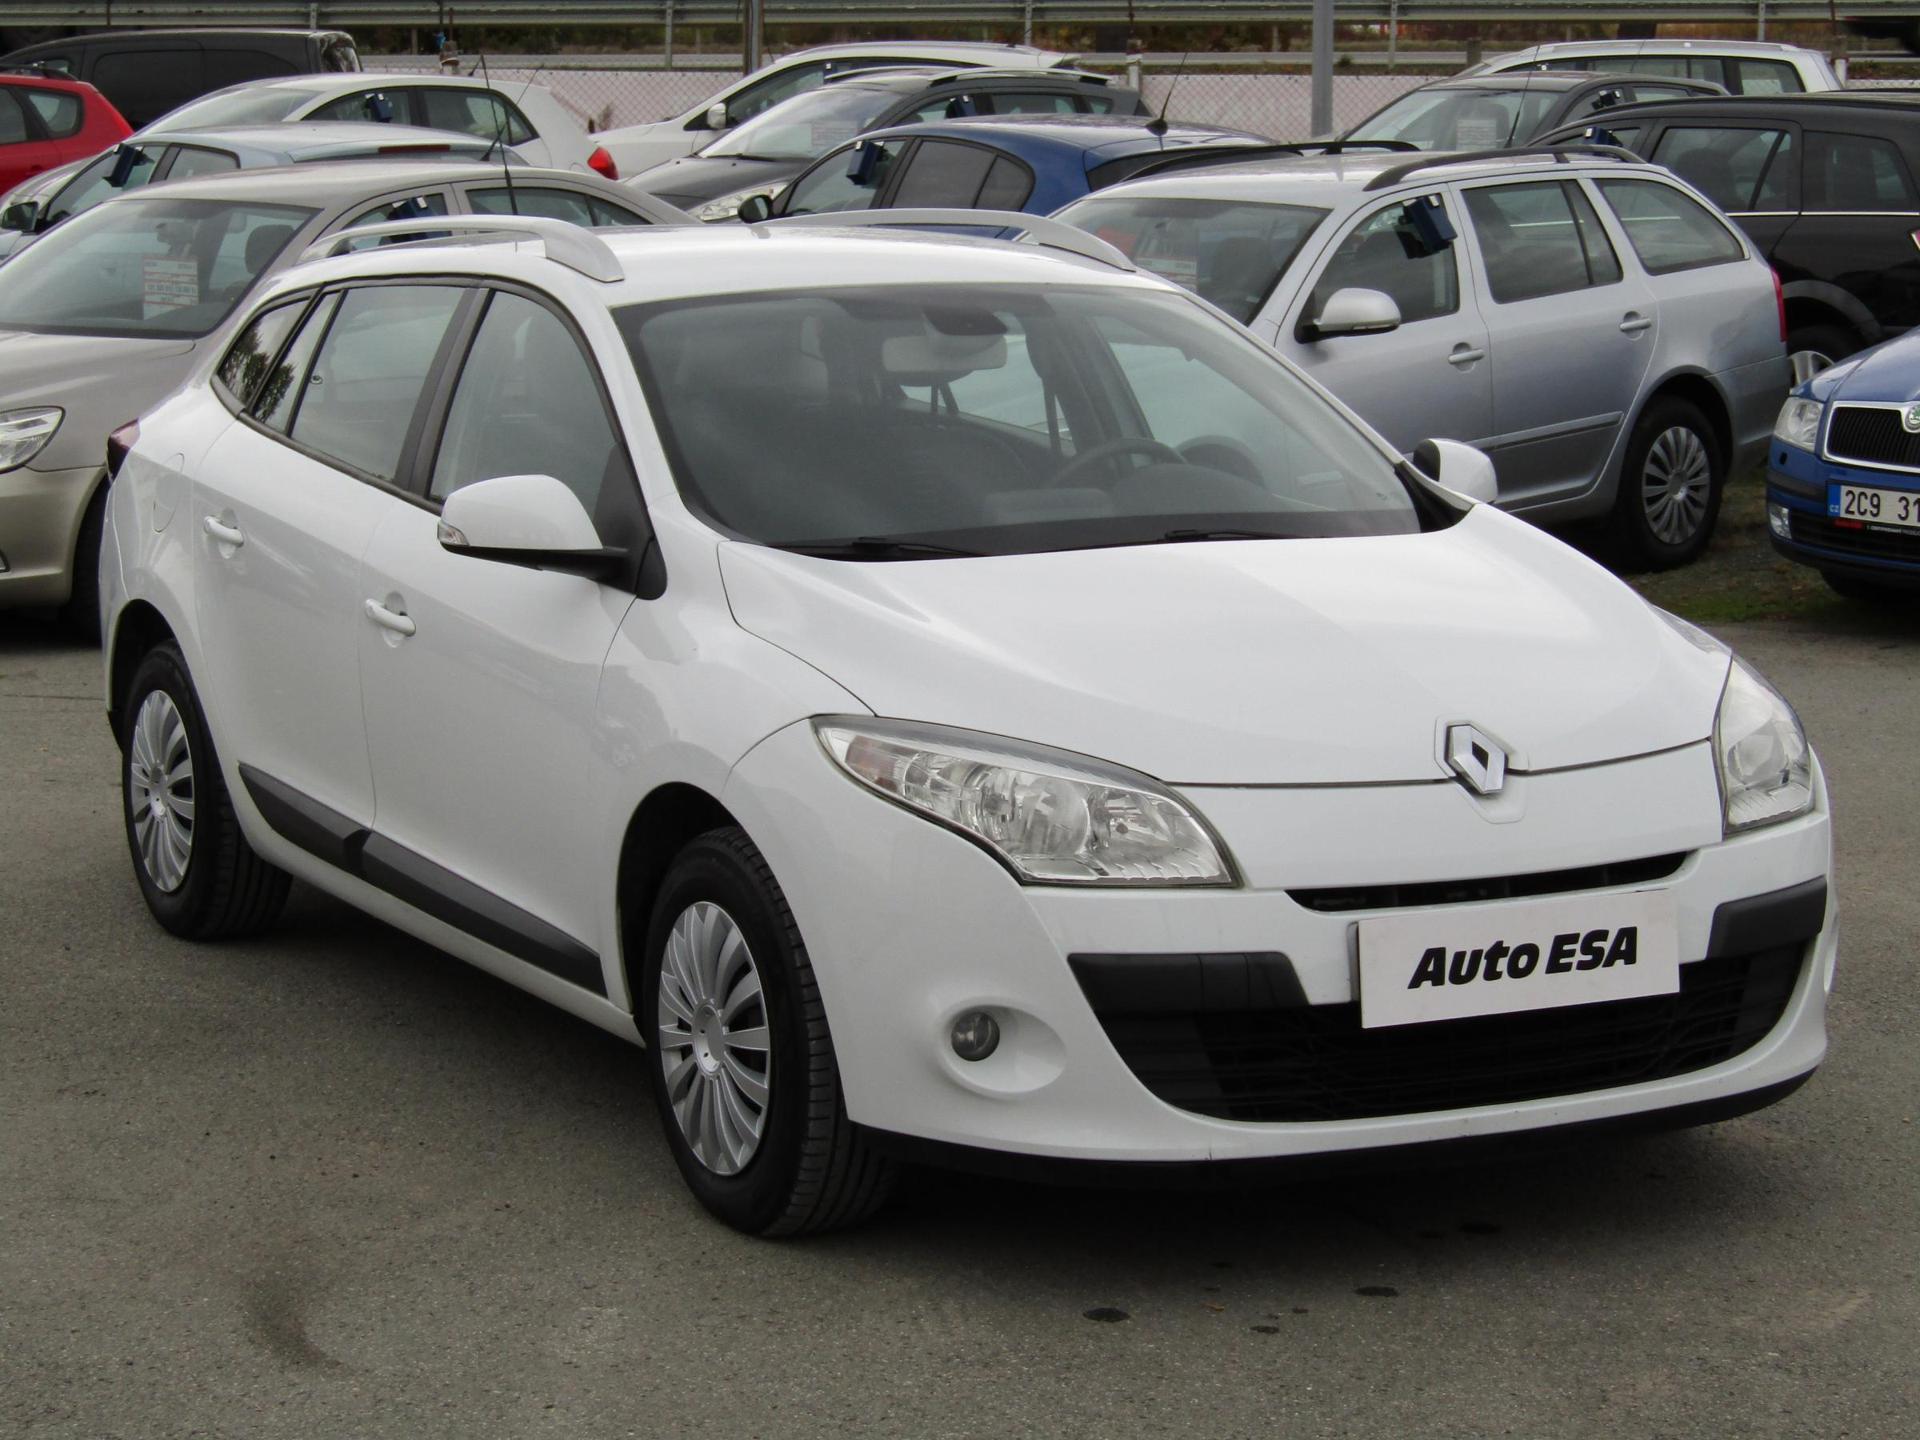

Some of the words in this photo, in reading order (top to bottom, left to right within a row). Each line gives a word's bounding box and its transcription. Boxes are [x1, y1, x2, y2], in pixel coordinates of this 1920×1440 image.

[1829, 504, 1840, 513] CZ
[1845, 489, 1880, 518] 2C9
[1407, 940, 1540, 989] Auto
[1545, 926, 1637, 974] ESA
